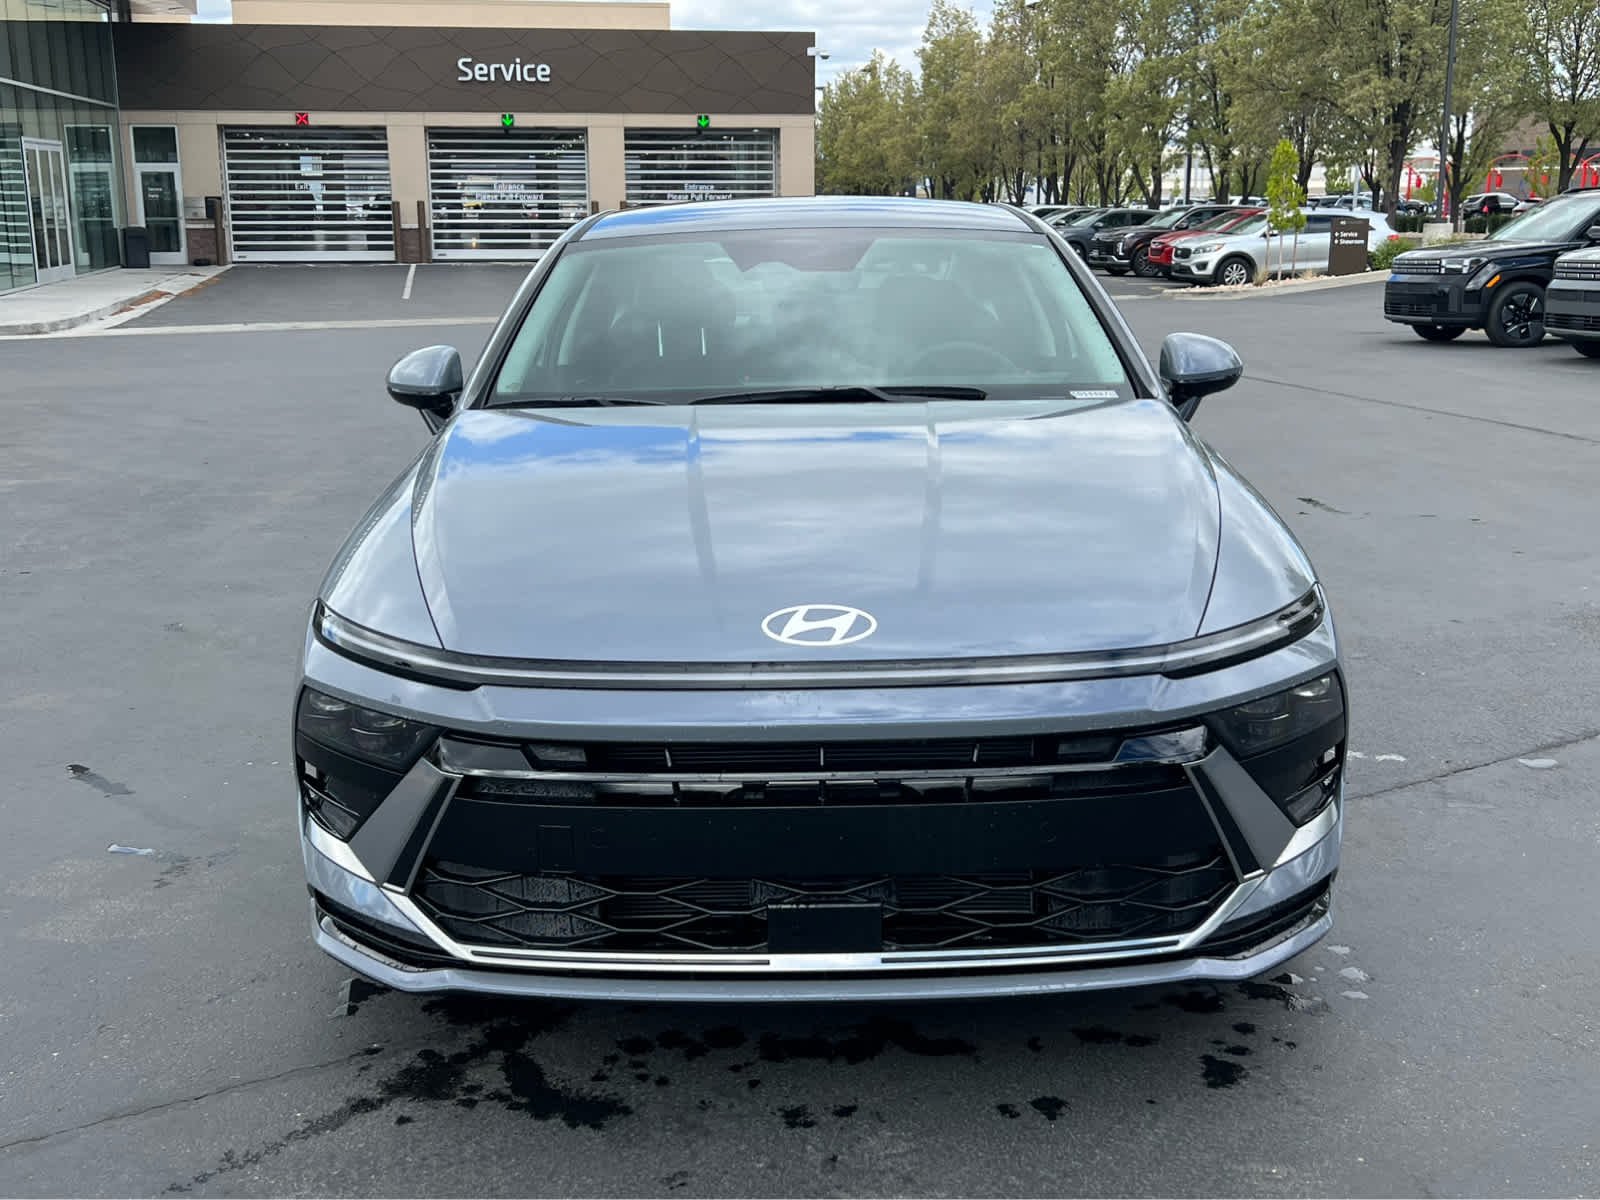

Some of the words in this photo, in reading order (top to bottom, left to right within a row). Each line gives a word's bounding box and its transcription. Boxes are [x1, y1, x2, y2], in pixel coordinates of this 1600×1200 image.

[457, 57, 551, 82] Service
[493, 182, 525, 191] Entrance
[684, 183, 715, 191] Entrance
[515, 192, 544, 201] Forward
[667, 192, 689, 201] Please
[691, 192, 703, 201] Pull
[705, 192, 732, 201] Forward
